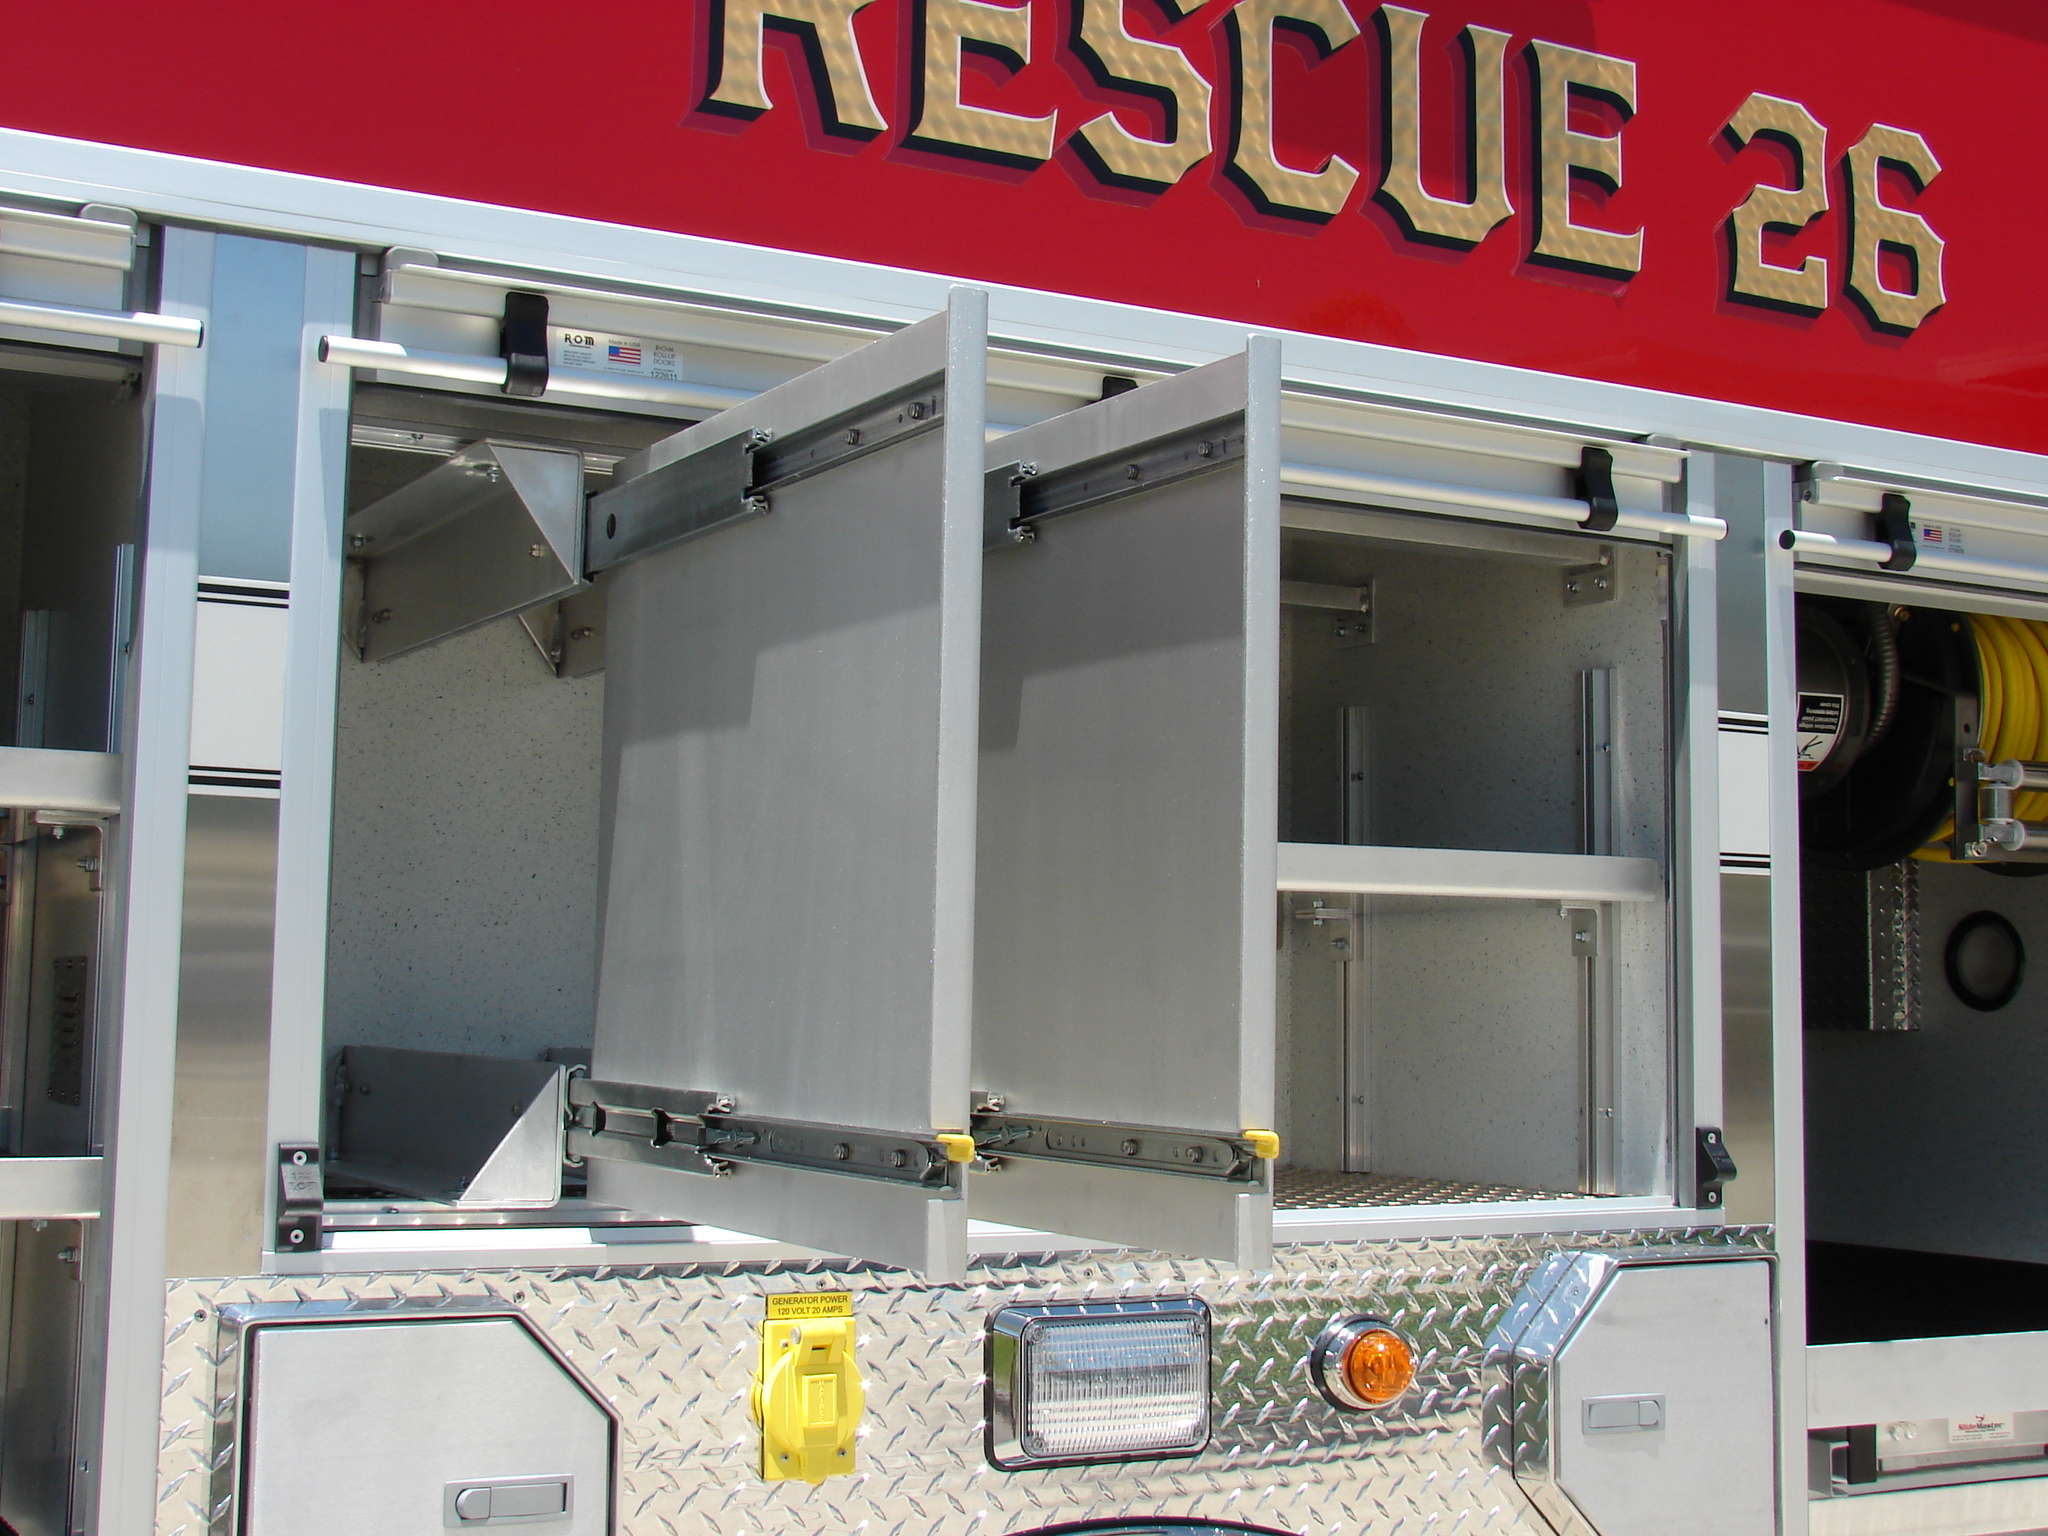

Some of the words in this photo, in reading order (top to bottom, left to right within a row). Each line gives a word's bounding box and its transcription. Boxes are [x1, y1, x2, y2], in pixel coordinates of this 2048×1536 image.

[1722, 92, 1947, 332] 26
[772, 1296, 819, 1306] GENERATOR
[820, 1294, 848, 1304] POWER
[778, 1307, 790, 1316] 120
[791, 1306, 811, 1315] VOLT
[811, 1306, 821, 1314] 20
[822, 1305, 843, 1314] AMPS
